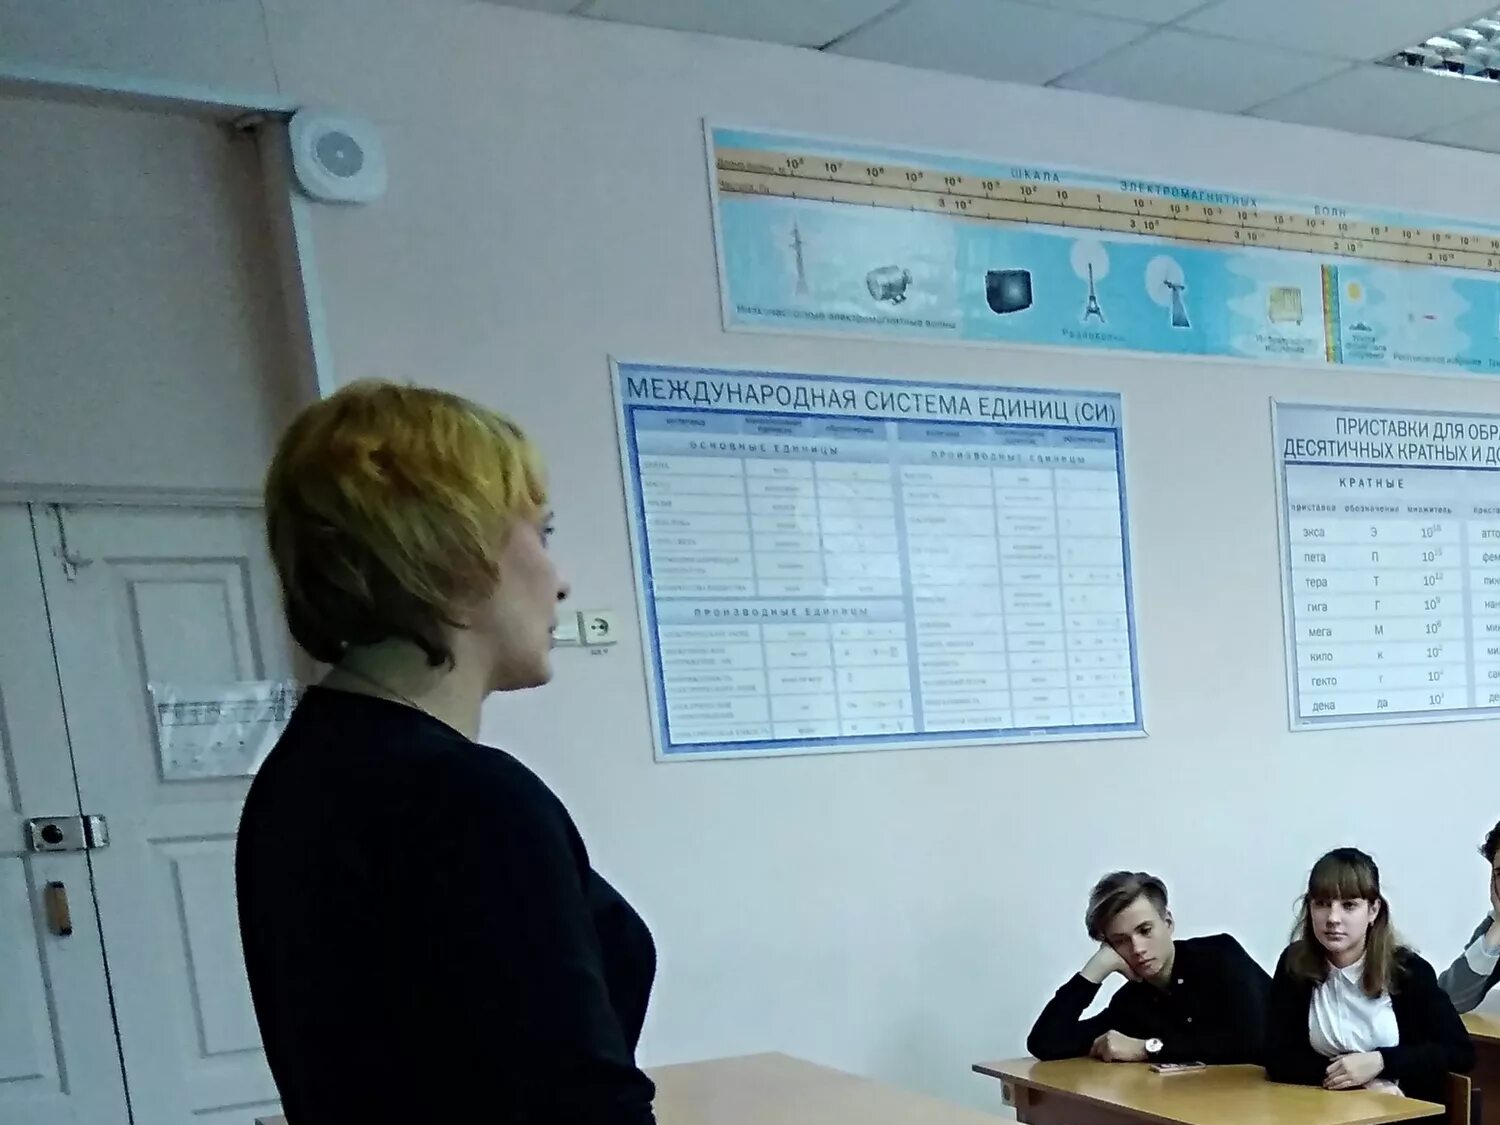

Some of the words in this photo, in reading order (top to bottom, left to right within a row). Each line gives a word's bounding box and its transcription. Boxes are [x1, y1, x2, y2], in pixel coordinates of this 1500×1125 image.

[1011, 167, 1060, 183] ШКАЛА
[627, 377, 856, 410] МЕЖДУНАРОДНАЯ
[864, 390, 972, 416] СИСТЕМА
[979, 397, 1069, 421] ЕДИНИЦ
[1075, 402, 1116, 425] (СИ)
[1336, 417, 1428, 438] ПРИСТАВКИ
[1433, 422, 1464, 441] ДЛЯ
[1284, 438, 1394, 459] ДЕСЯТИЧНЫХ
[1398, 443, 1467, 462] КРАТНЫХ
[1472, 446, 1482, 461] И
[1339, 478, 1404, 489] КРАТНЫЕ
[1305, 577, 1328, 589] тера
[1307, 602, 1328, 612] гига
[1309, 627, 1332, 637] мега
[1310, 652, 1333, 662] кило
[1311, 676, 1337, 687] гекто
